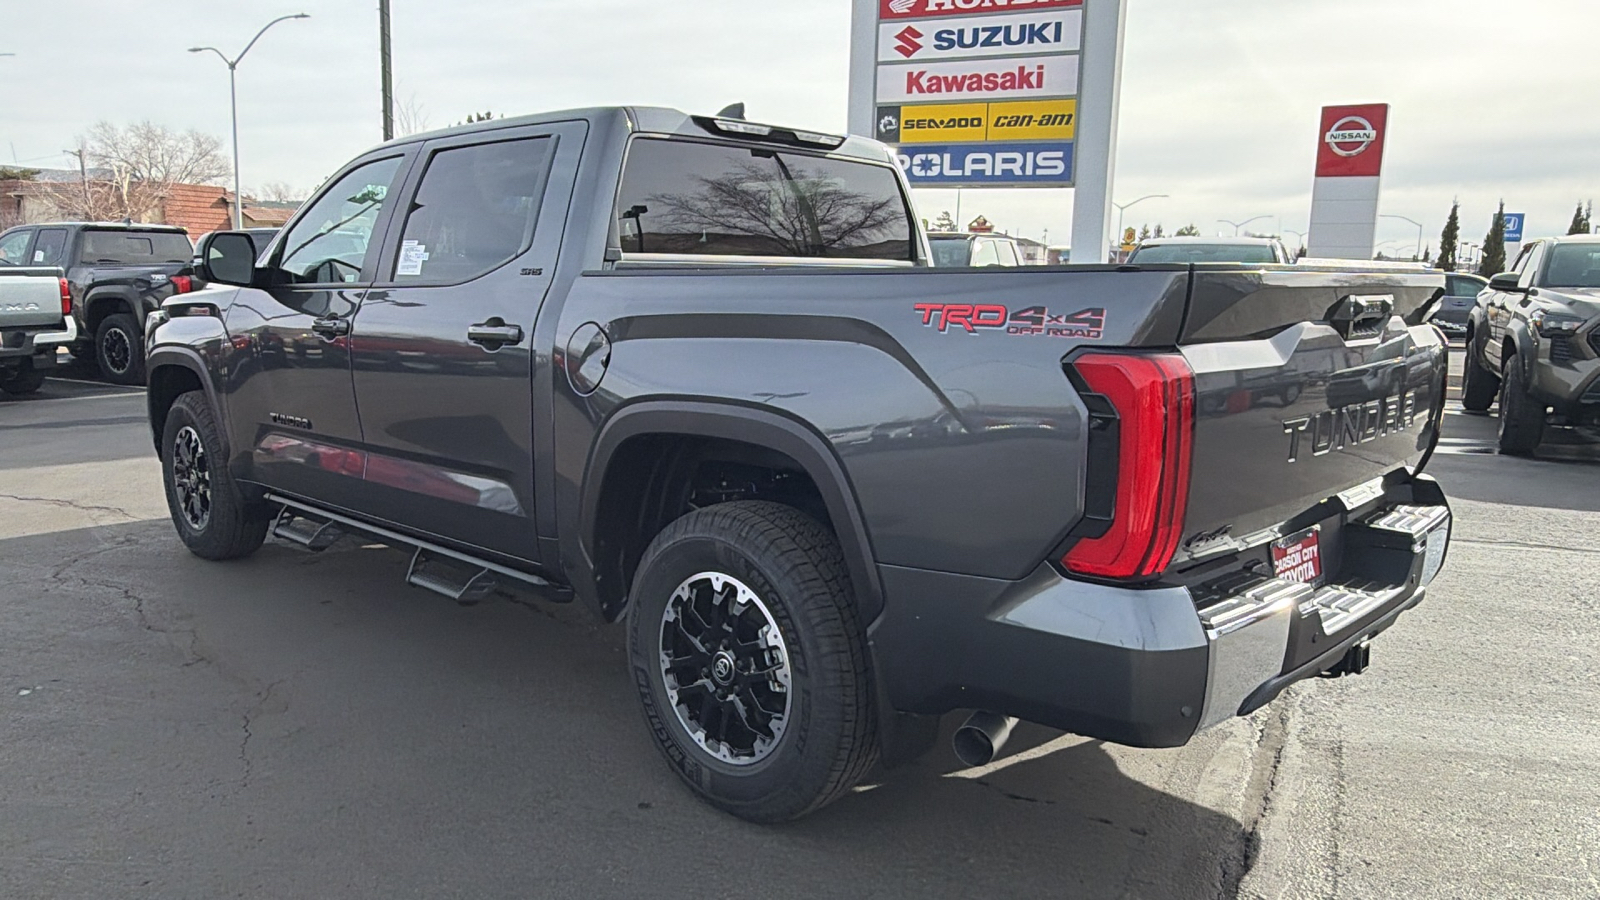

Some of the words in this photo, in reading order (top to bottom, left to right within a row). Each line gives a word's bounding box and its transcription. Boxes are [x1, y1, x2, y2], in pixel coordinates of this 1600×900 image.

[933, 21, 1062, 51] SUZUKI
[906, 65, 1044, 94] Kawasaki
[1329, 132, 1372, 140] NISSAN
[914, 303, 1009, 336] TRD
[1006, 326, 1044, 337] OFF
[1046, 328, 1103, 340] ROAD
[1282, 391, 1415, 463] TUNDRA
[1302, 544, 1318, 561] CITY
